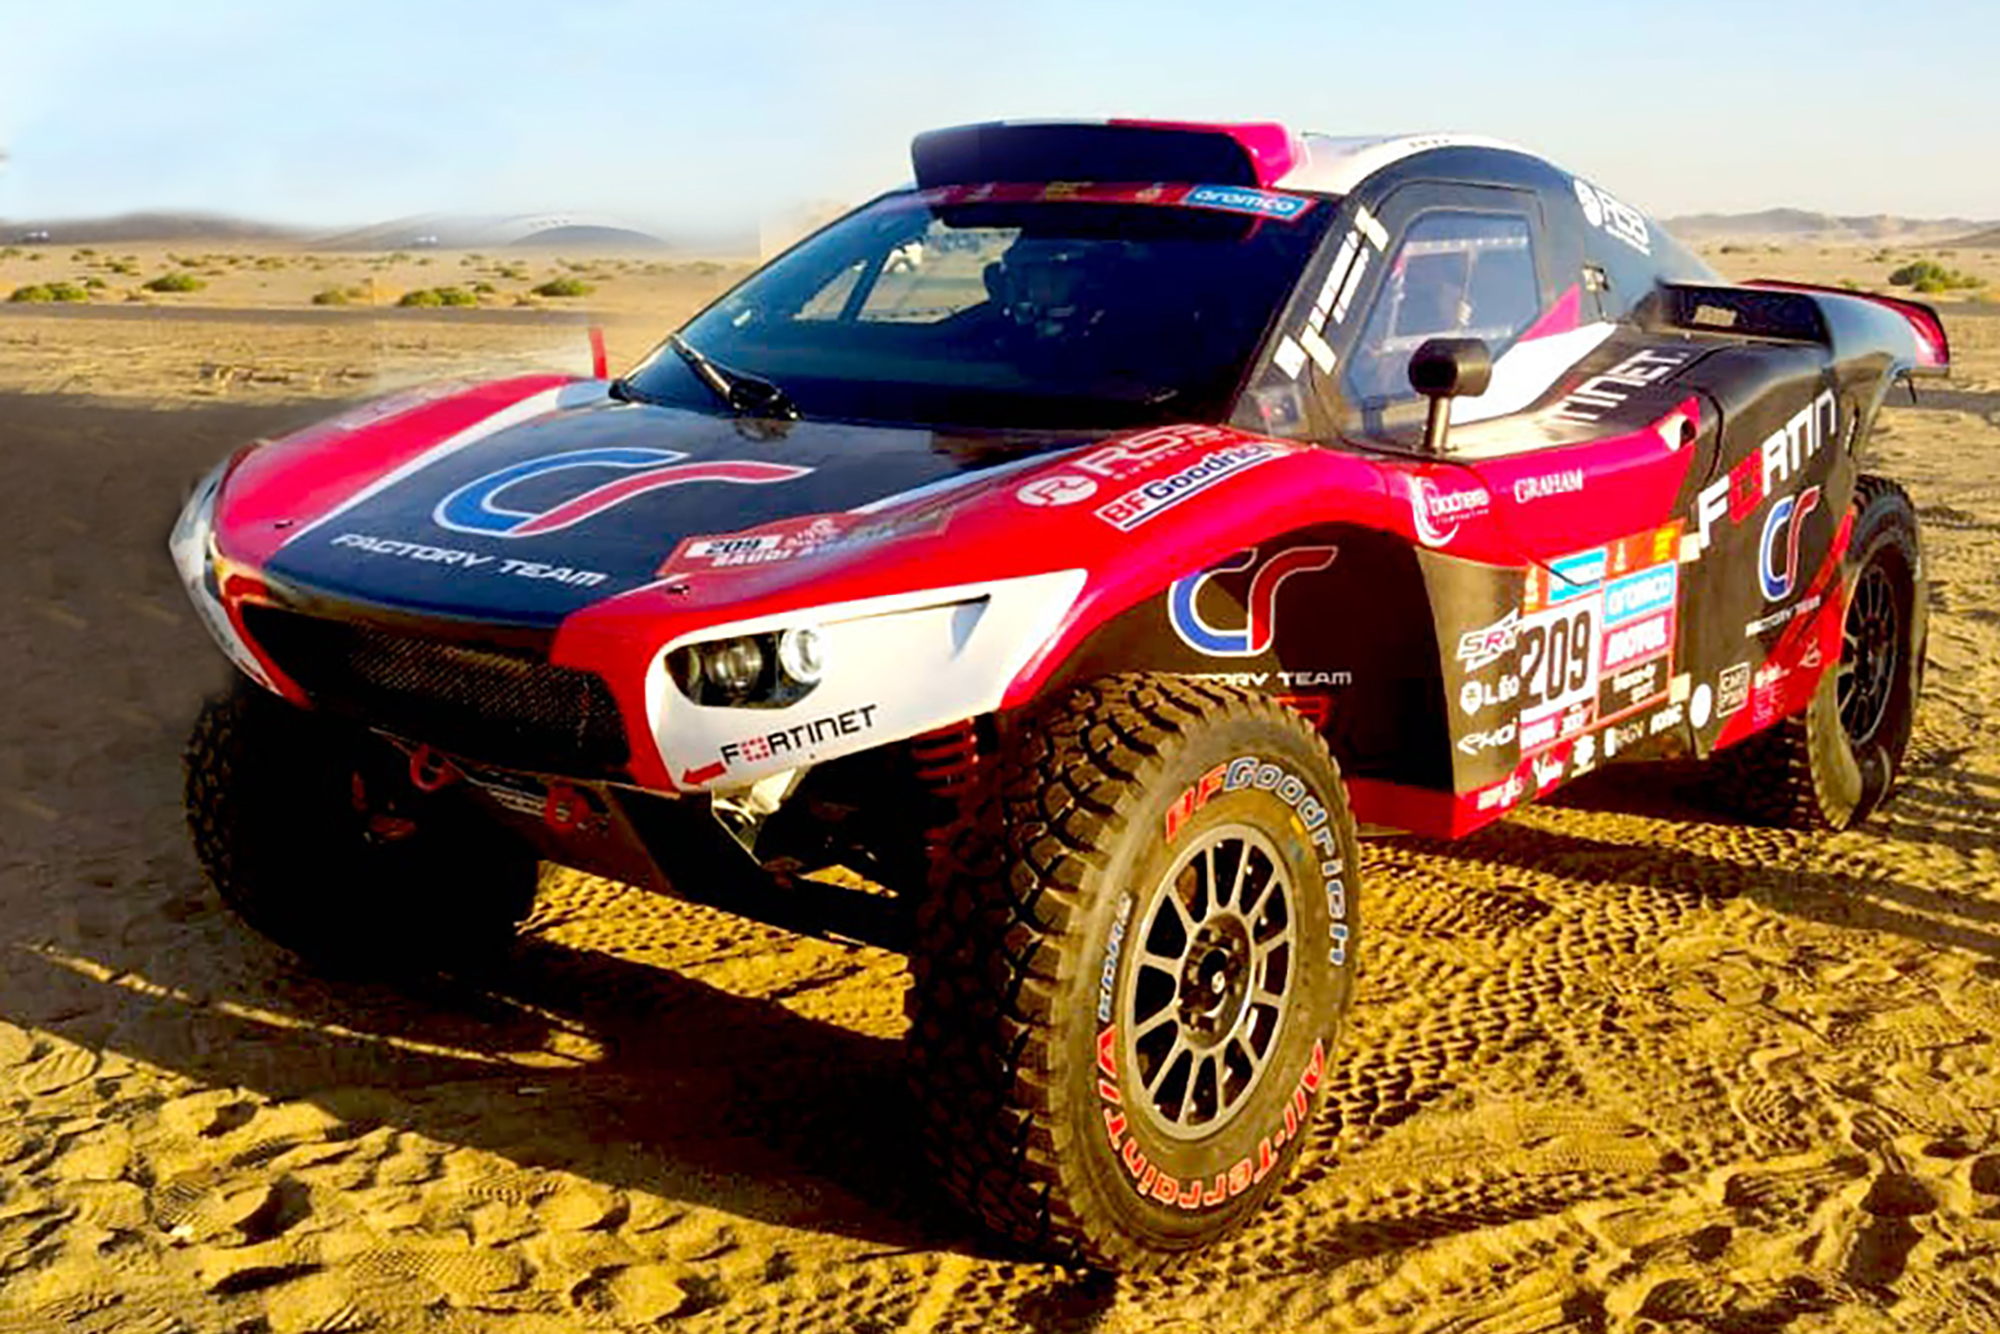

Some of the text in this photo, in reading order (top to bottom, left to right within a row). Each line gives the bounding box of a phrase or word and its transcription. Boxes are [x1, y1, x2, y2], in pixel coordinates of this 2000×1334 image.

[1194, 189, 1294, 212] aramco
[330, 533, 606, 587] FACTORY TEAM
[1277, 671, 1352, 687] TEAM
[1519, 610, 1591, 711] 209
[721, 704, 877, 765] FORTINET
